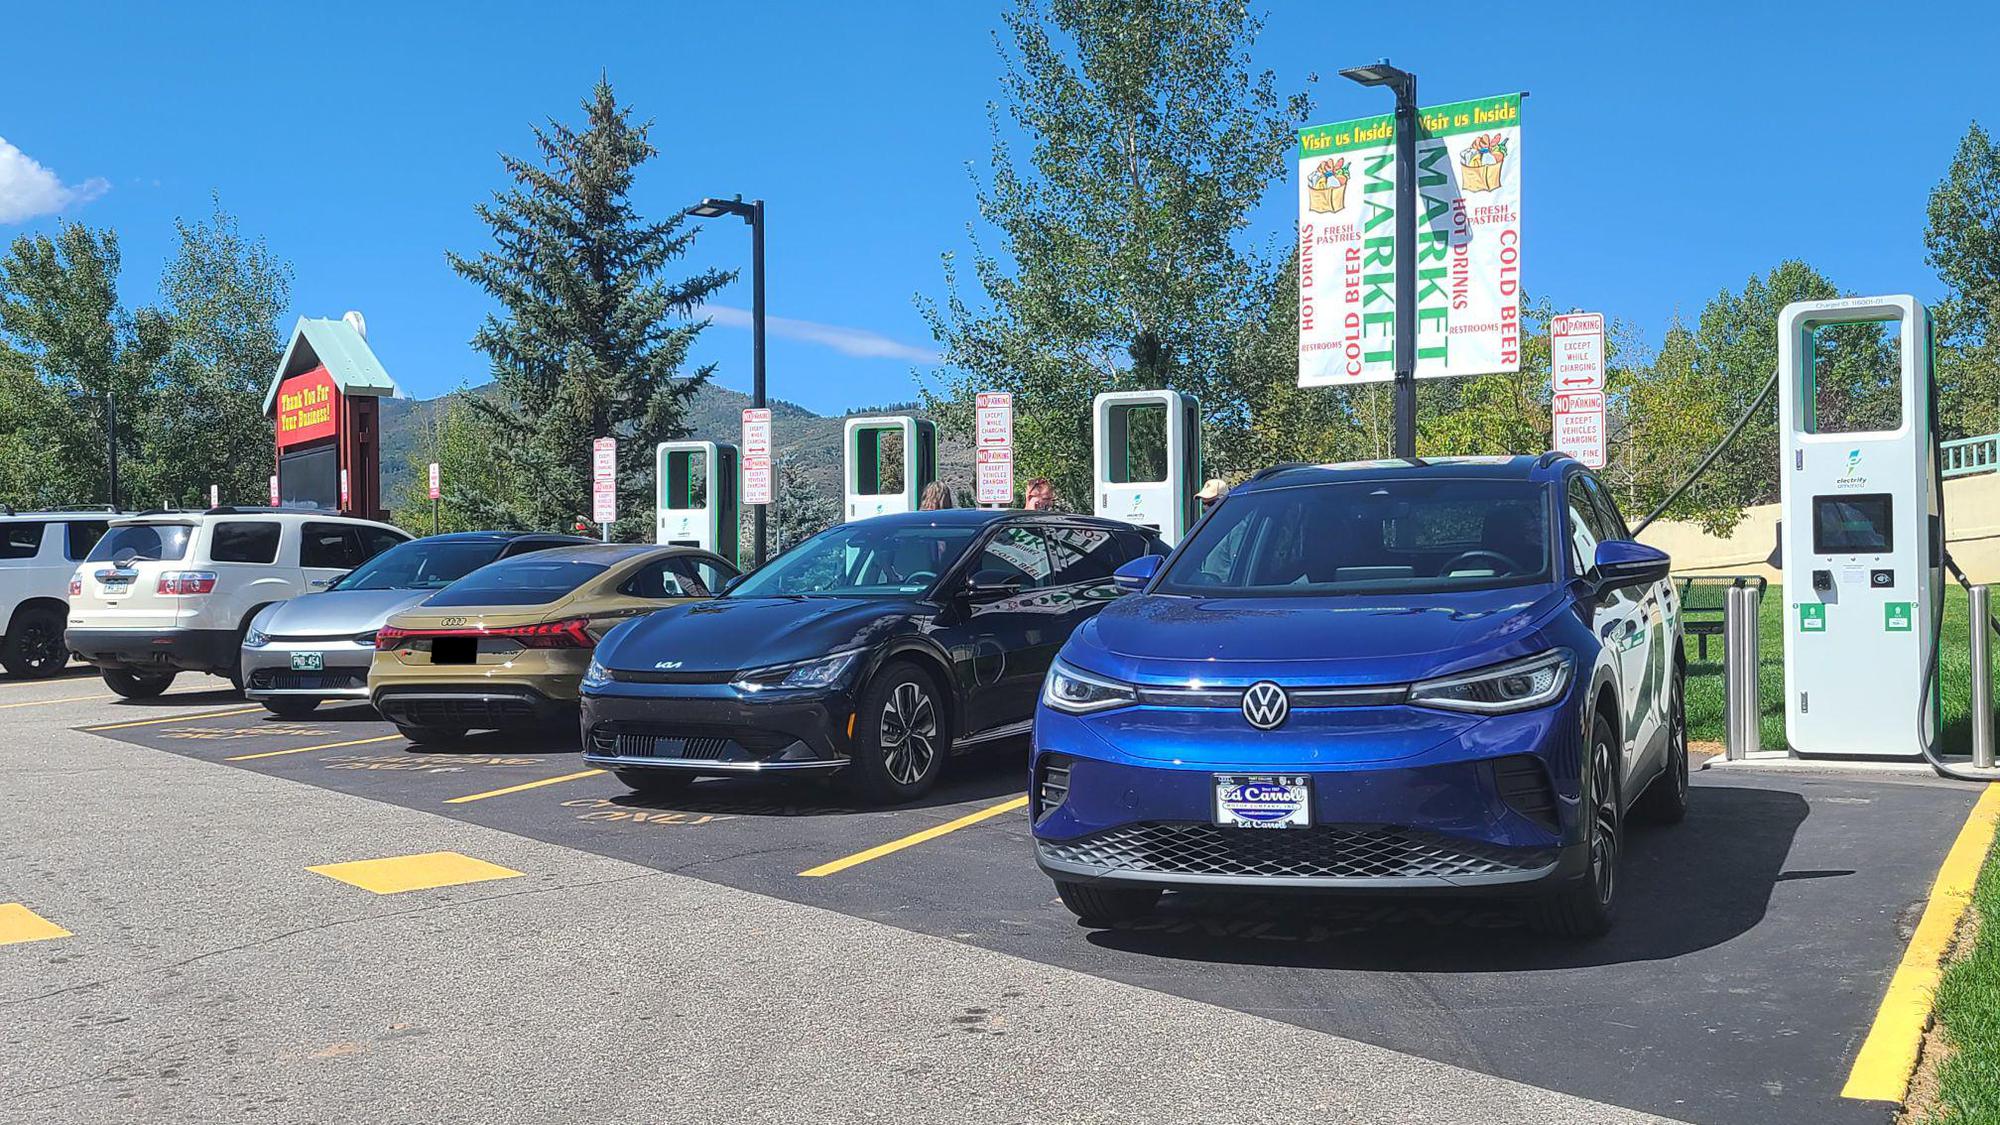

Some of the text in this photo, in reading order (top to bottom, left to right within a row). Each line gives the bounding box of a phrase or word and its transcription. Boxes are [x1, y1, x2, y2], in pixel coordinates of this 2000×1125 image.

[1475, 204, 1508, 216] FRESH
[1467, 212, 1517, 226] PASTRIES
[1324, 224, 1353, 236] FRESH
[1317, 232, 1361, 245] PASTRIES
[1418, 147, 1449, 368] MARKET
[1453, 198, 1468, 310] HOT DRINKS
[1363, 153, 1394, 370] MARKET
[1302, 224, 1313, 331] HOT DRINKS
[1500, 230, 1517, 364] COLD BEER
[1345, 248, 1361, 376] COLD BEER
[1450, 323, 1499, 334] RESTROOMS
[1554, 319, 1600, 335] NO PARKING
[1302, 341, 1342, 352] RESTROOMS
[1564, 341, 1591, 351] EXCEPT
[1567, 353, 1588, 361] WHILE
[1560, 363, 1596, 373] CHARGING
[282, 391, 302, 412] Thank
[304, 388, 315, 406] You
[1555, 397, 1601, 413] NO PARKING
[282, 415, 297, 431] Your
[1565, 417, 1592, 425] EXCEPT
[1562, 426, 1596, 434] VEHICLES
[1562, 435, 1598, 445] CHARGING
[1583, 450, 1599, 458] FINE
[1220, 787, 1304, 801] Ed Carroll
[1238, 820, 1251, 828] Ed
